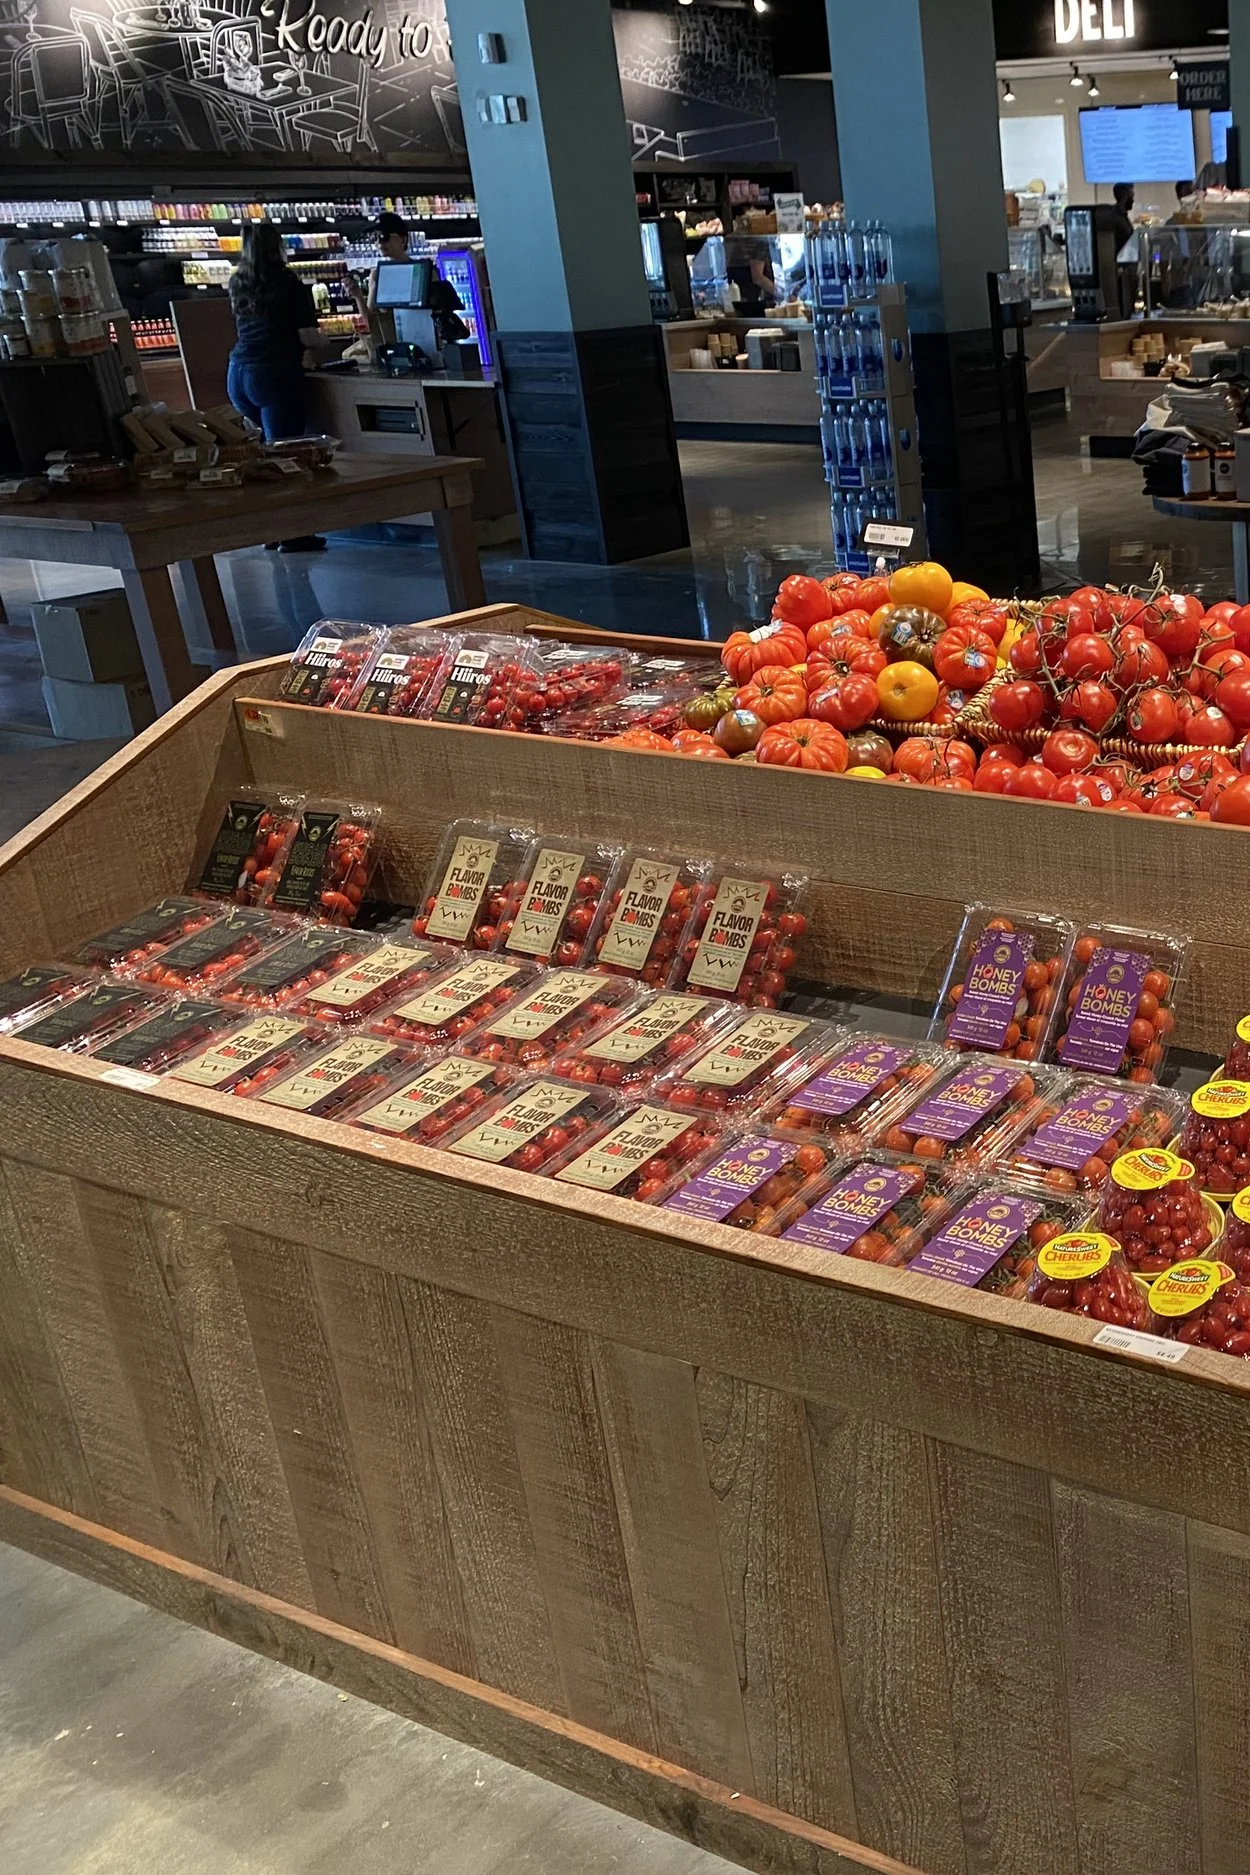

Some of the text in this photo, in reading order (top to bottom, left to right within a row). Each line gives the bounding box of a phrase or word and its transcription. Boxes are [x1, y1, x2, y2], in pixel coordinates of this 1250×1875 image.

[1055, 0, 1134, 43] DELI
[261, 0, 432, 68] Ready to
[1180, 70, 1226, 85] ORDER
[1185, 86, 1222, 101] HERE
[304, 652, 343, 668] Hiiros
[371, 668, 411, 685] Hiiros
[451, 667, 493, 686] Hiiros
[451, 868, 485, 885] FLAVOR
[446, 883, 478, 900] BOMBS
[532, 881, 568, 900] FLAVOR
[527, 897, 562, 916] BOMBS
[625, 892, 663, 912] FLAVOR
[620, 908, 656, 928] BOMBS
[713, 912, 754, 932] FLAVOR
[708, 928, 748, 948] BOMBS
[357, 963, 399, 975] FLAVOR
[973, 964, 1021, 982] HONEY
[446, 978, 490, 994] FLAVOR
[969, 979, 1016, 995] BOMBS
[1085, 984, 1136, 1004] HONEY
[534, 992, 580, 1006] FLAVOR
[1081, 998, 1131, 1017] BOMBS
[524, 1001, 568, 1015] BOMBS
[633, 1017, 679, 1029] FLAVOR
[623, 1026, 667, 1040] BOMBS
[229, 1036, 273, 1052] FLAVOR
[731, 1034, 781, 1051] FLAVOR
[720, 1045, 768, 1061] BOMBS
[318, 1058, 364, 1073] FLAVOR
[836, 1062, 889, 1076] HONEY
[305, 1068, 348, 1083] BOMBS
[828, 1068, 880, 1085] BOMBS
[416, 1078, 462, 1094] FLAVOR
[947, 1083, 1001, 1098] HONEY
[401, 1089, 445, 1106] BOMBS
[938, 1091, 991, 1108] BOMBS
[1198, 1094, 1248, 1105] CHERUBS
[506, 1104, 556, 1123] FLAVOR
[1063, 1108, 1121, 1126] HONEY
[492, 1116, 541, 1134] BOMBS
[1056, 1116, 1112, 1134] BOMBS
[612, 1130, 664, 1149] FLAVOR
[600, 1142, 649, 1160] BOMBS
[717, 1159, 773, 1176] HONEY
[1124, 1156, 1167, 1181] CHERUBS
[1140, 1154, 1170, 1171] NATURESWEET
[707, 1167, 761, 1185] BOMBS
[833, 1188, 891, 1207] HONEY
[823, 1197, 881, 1217] BOMBS
[955, 1216, 1018, 1238] HONEY
[946, 1226, 1007, 1248] BOMBS
[1045, 1251, 1102, 1261] CHERUBS
[1054, 1243, 1098, 1252] NATURESWEET
[1170, 1273, 1209, 1282] NATURESWEET
[1157, 1281, 1209, 1294] CHERUBS
